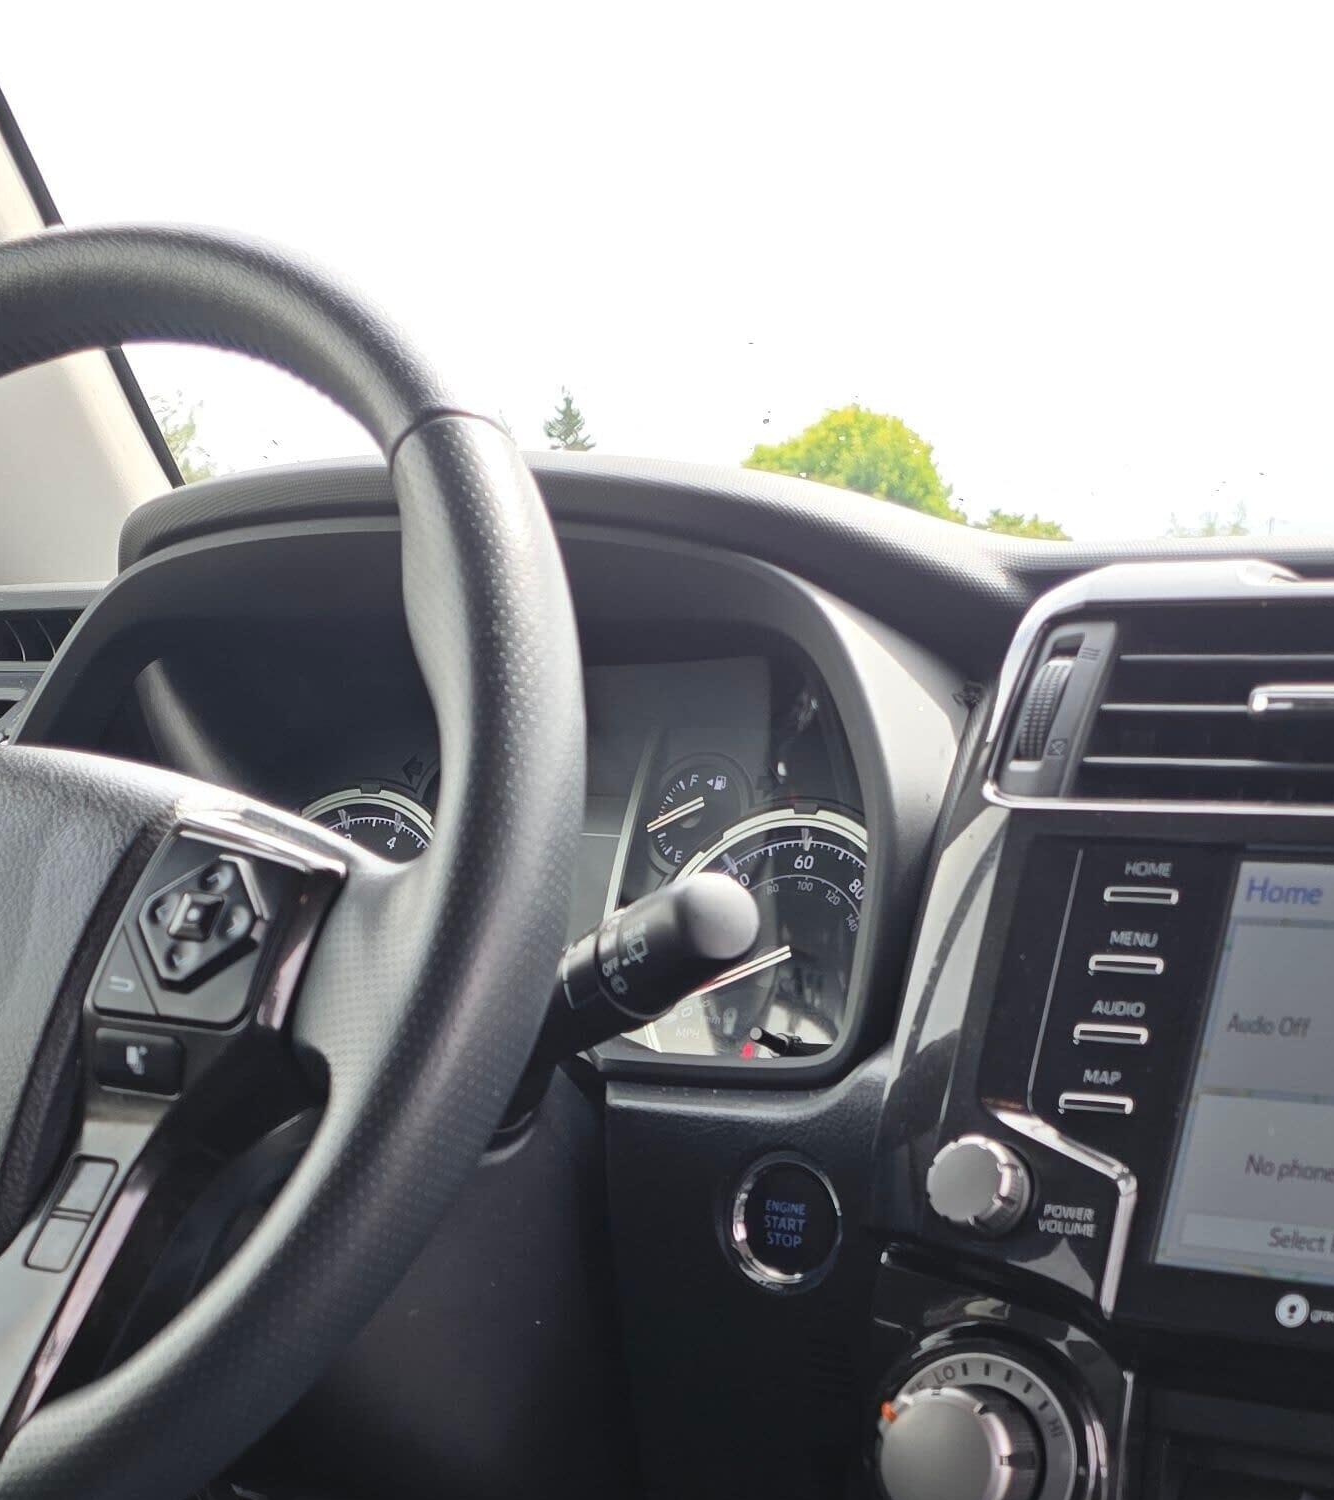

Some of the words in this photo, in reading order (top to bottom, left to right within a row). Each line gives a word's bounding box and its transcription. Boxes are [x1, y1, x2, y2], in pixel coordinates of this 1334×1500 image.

[689, 774, 699, 787] F
[386, 837, 397, 849] 4
[673, 850, 683, 864] E
[793, 854, 815, 870] 60
[848, 879, 866, 901] 80
[1124, 861, 1172, 877] HOME
[1246, 876, 1324, 905] Home
[796, 881, 814, 893] 100
[824, 890, 841, 907] 120
[845, 913, 860, 933] 140
[1109, 930, 1159, 948] MENU
[1092, 1000, 1146, 1018] AUDIO
[1278, 1015, 1313, 1038] Off
[1082, 1069, 1122, 1086] MAP
[1244, 1153, 1275, 1178] No
[765, 1200, 806, 1216] ENGINE
[1043, 1203, 1095, 1222] POWER
[763, 1215, 806, 1232] START
[1037, 1218, 1097, 1239] VOLUME
[766, 1231, 803, 1248] STOP
[1268, 1226, 1326, 1255] Select
[933, 1364, 957, 1386] LO
